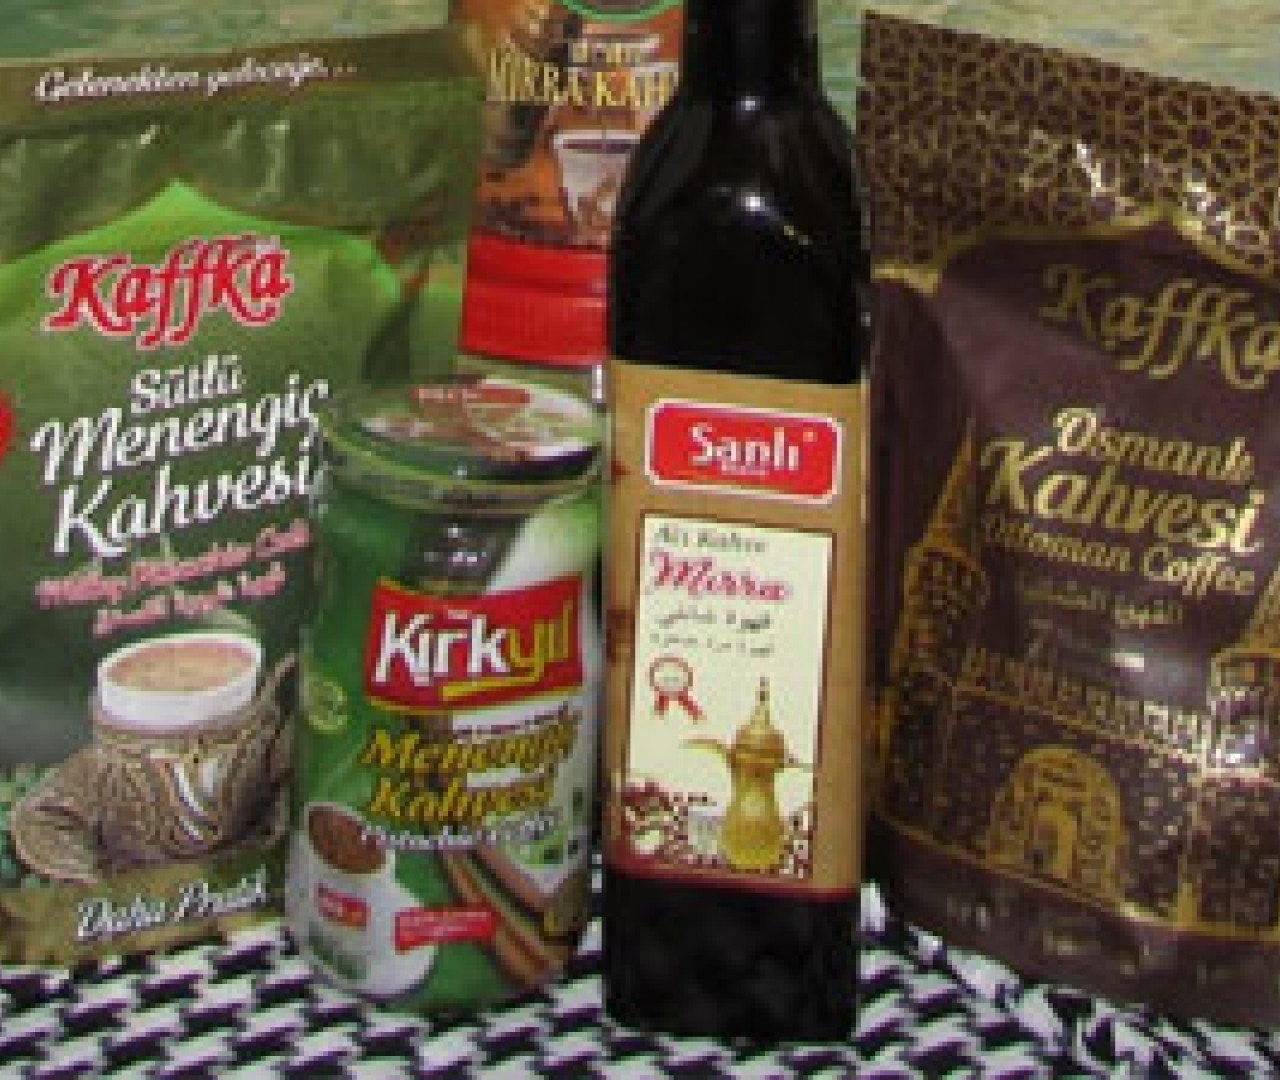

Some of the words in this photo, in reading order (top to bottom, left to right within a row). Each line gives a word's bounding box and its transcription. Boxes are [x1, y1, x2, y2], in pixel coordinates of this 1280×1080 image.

[42, 231, 293, 350] Kaffka
[30, 372, 333, 487] Menengiç
[130, 354, 245, 418] Sütlü
[51, 435, 328, 560] Kahvesi
[978, 437, 1266, 555] Kahvesi
[1054, 406, 1256, 486] Osmanlı
[1140, 541, 1258, 597] Coffee
